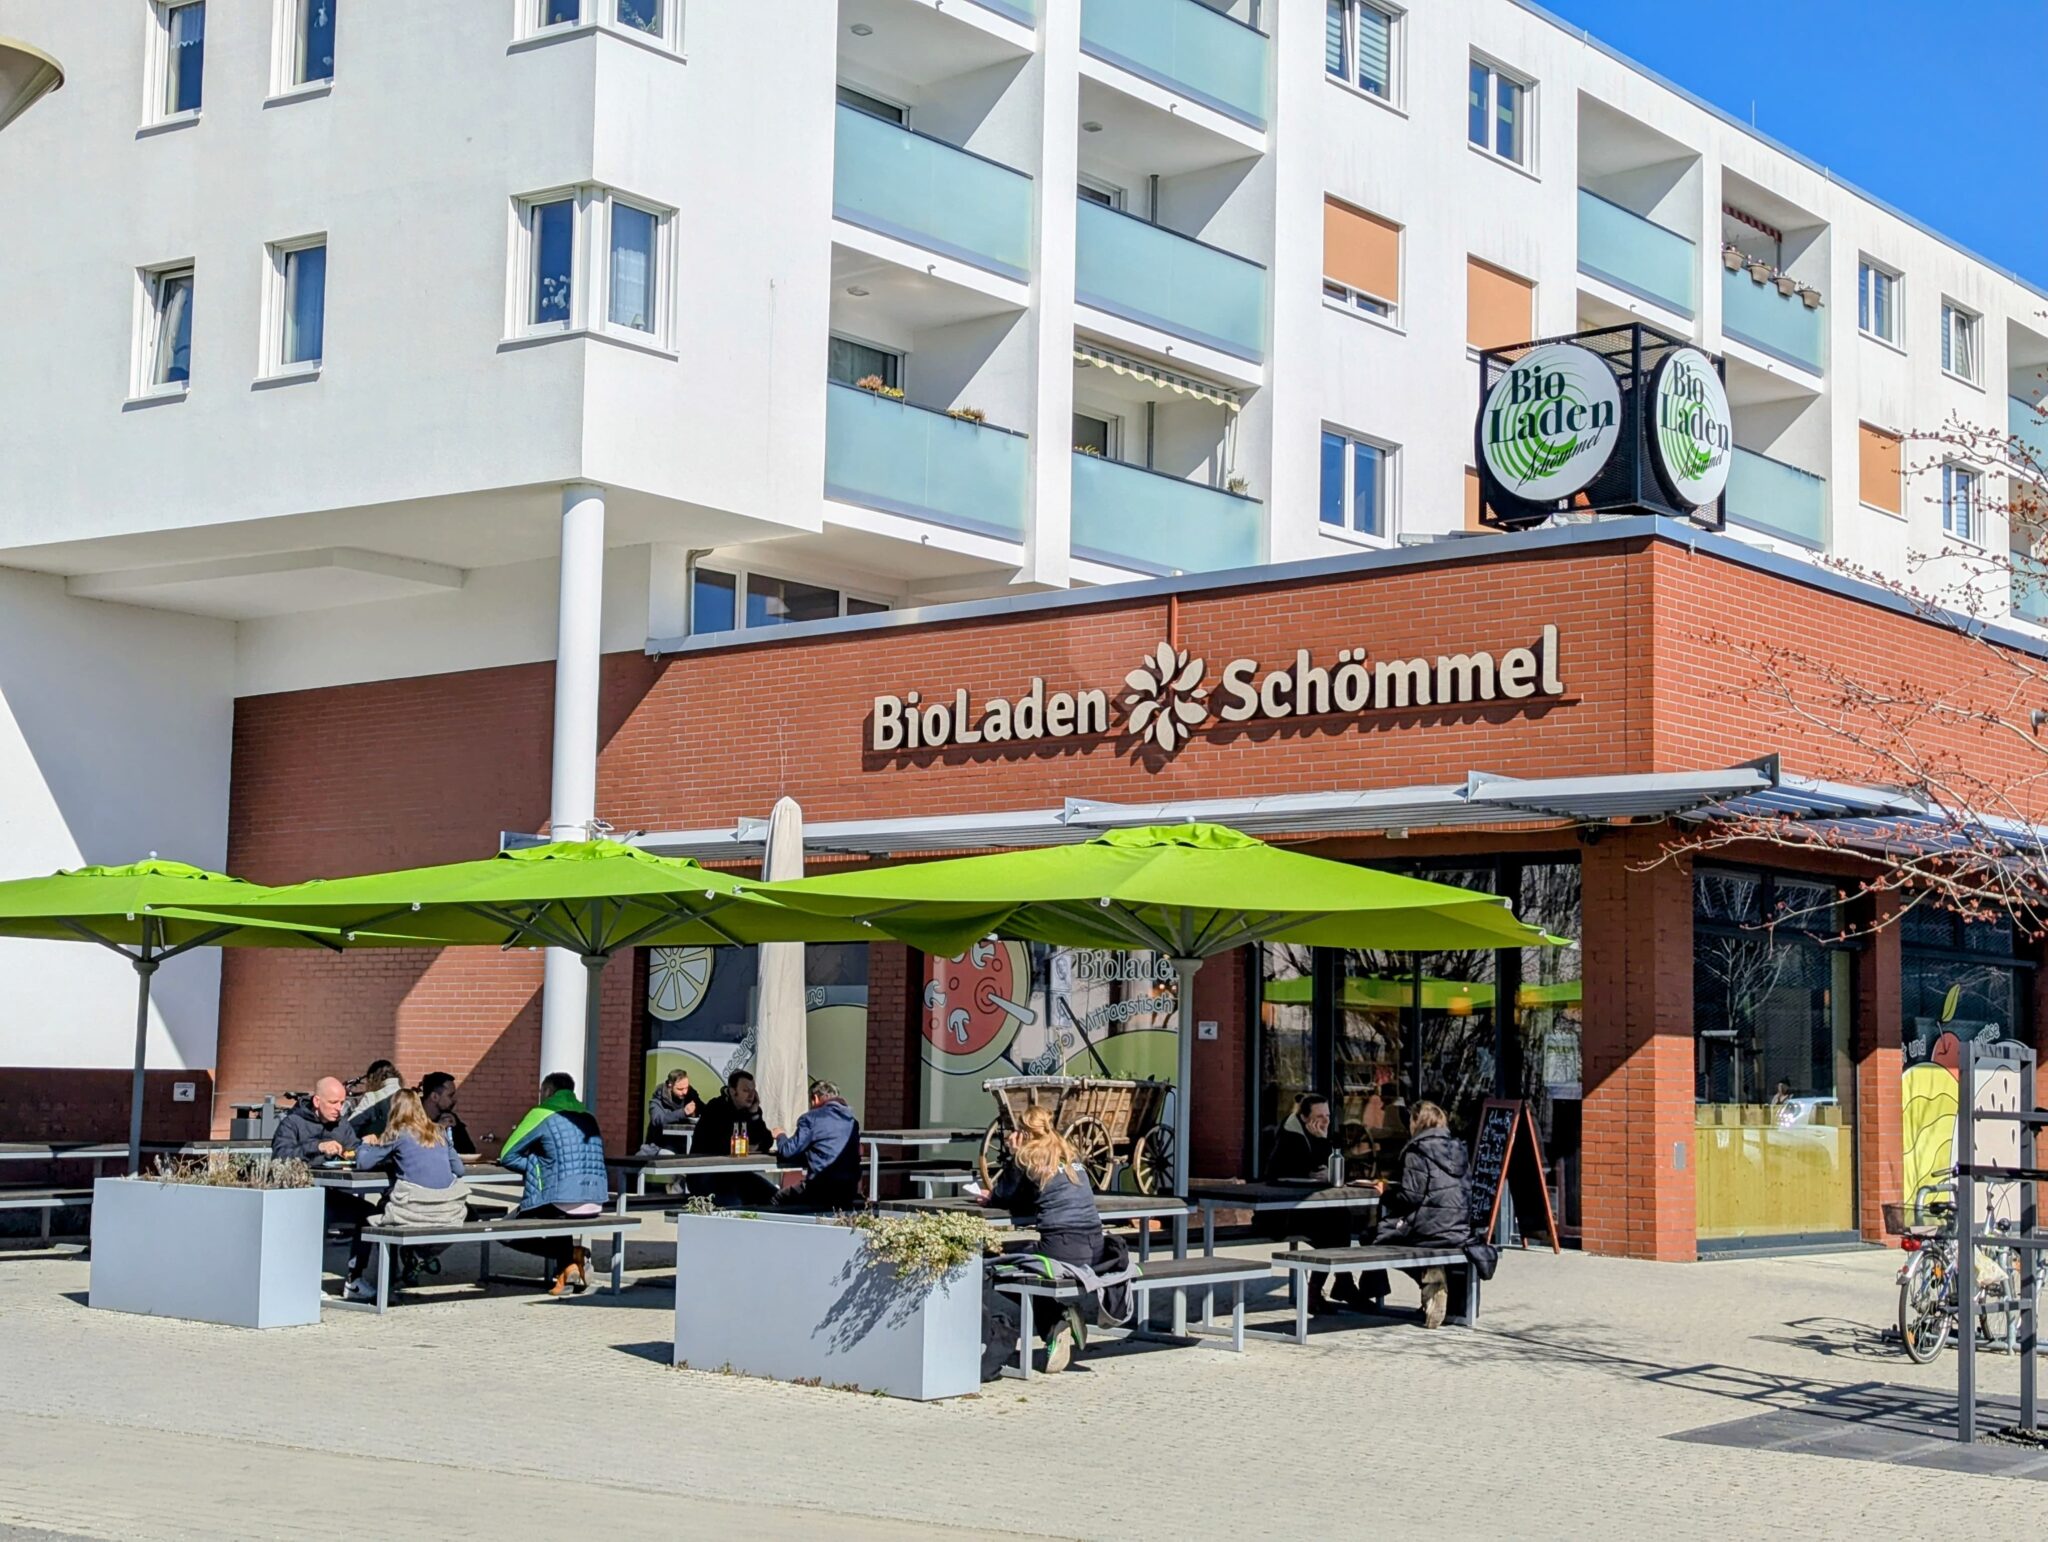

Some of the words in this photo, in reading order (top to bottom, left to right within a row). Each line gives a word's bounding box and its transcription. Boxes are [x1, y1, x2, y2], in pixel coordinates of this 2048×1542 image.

[1509, 365, 1566, 405] Bio
[1672, 360, 1705, 405] Bio
[1488, 399, 1616, 445] Laden
[1660, 392, 1731, 452] Laden
[1516, 422, 1604, 490] Schömmel
[873, 677, 1110, 752] BioLaden
[1221, 624, 1564, 721] Schömmel
[1027, 1031, 1074, 1077] Bistro
[1078, 992, 1174, 1033] Mittagstisch
[1908, 1034, 1926, 1058] und
